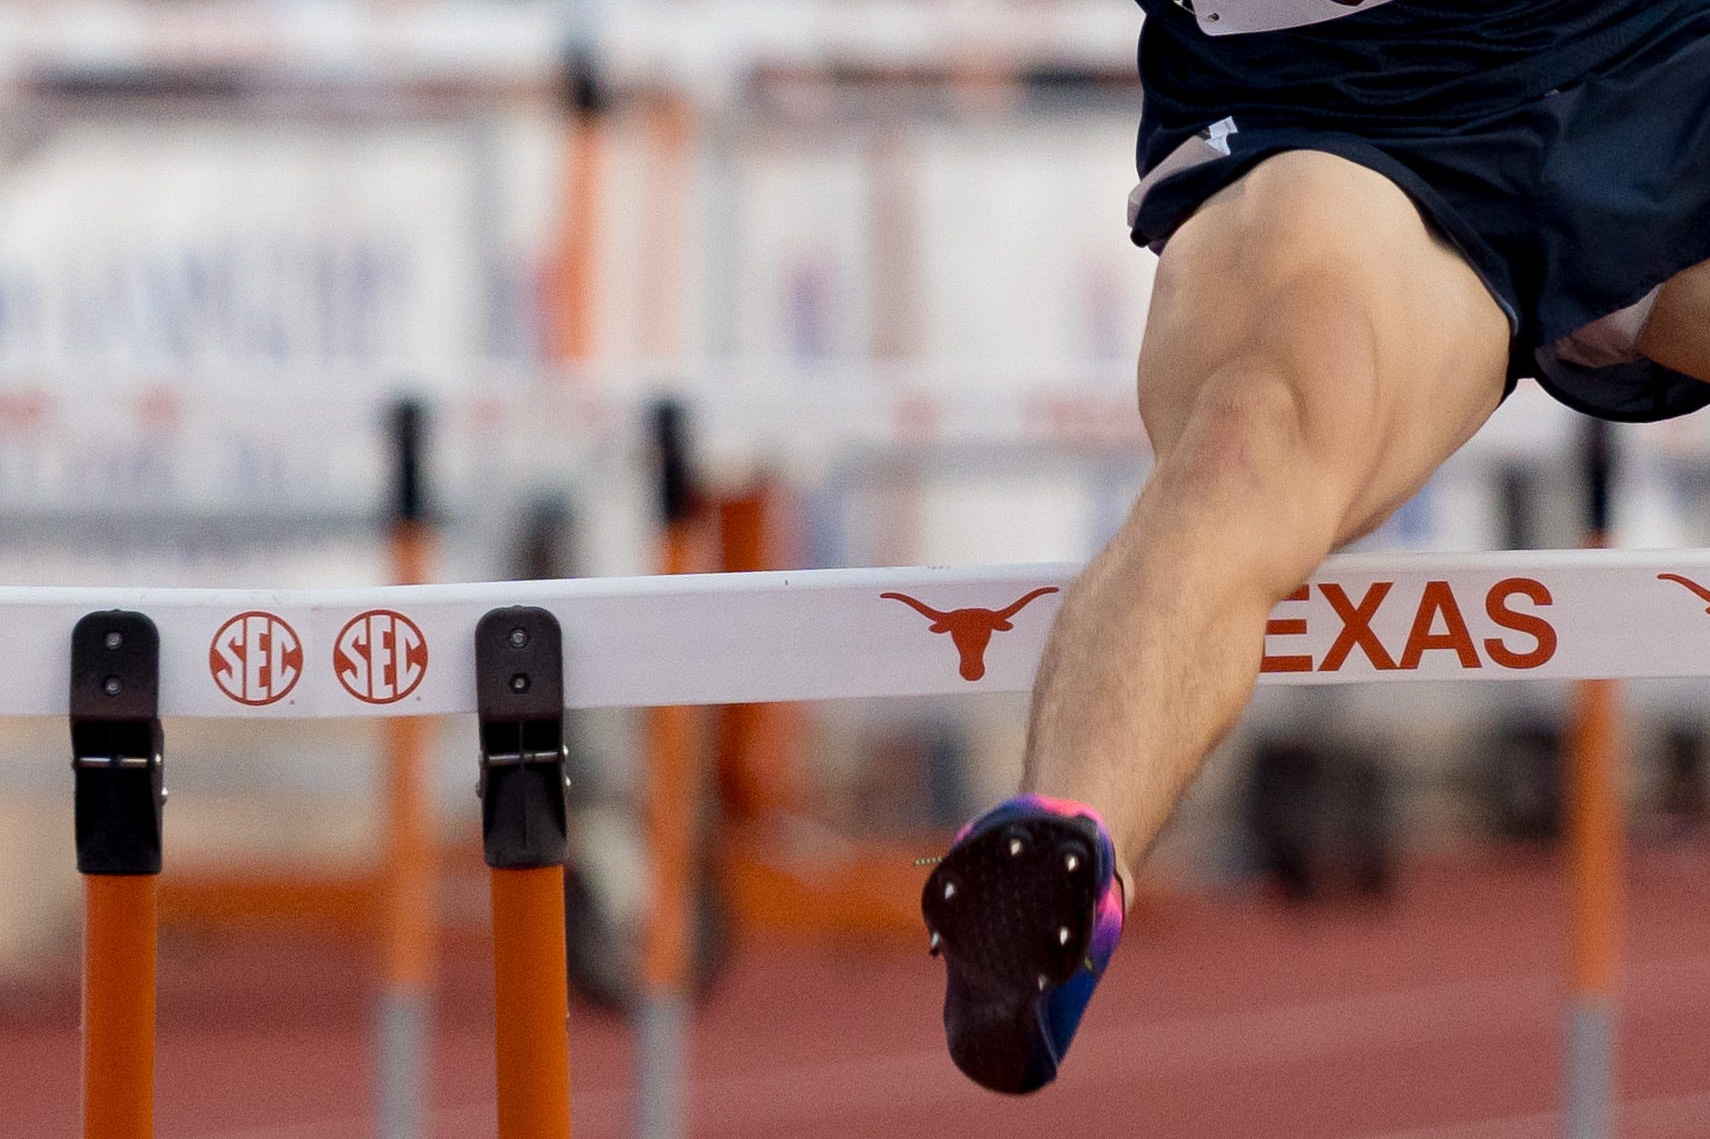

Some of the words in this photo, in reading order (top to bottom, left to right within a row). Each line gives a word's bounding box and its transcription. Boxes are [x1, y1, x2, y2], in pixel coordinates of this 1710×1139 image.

[215, 616, 297, 700] SEC
[339, 614, 422, 699] SEC
[1259, 577, 1558, 673] EXAS
